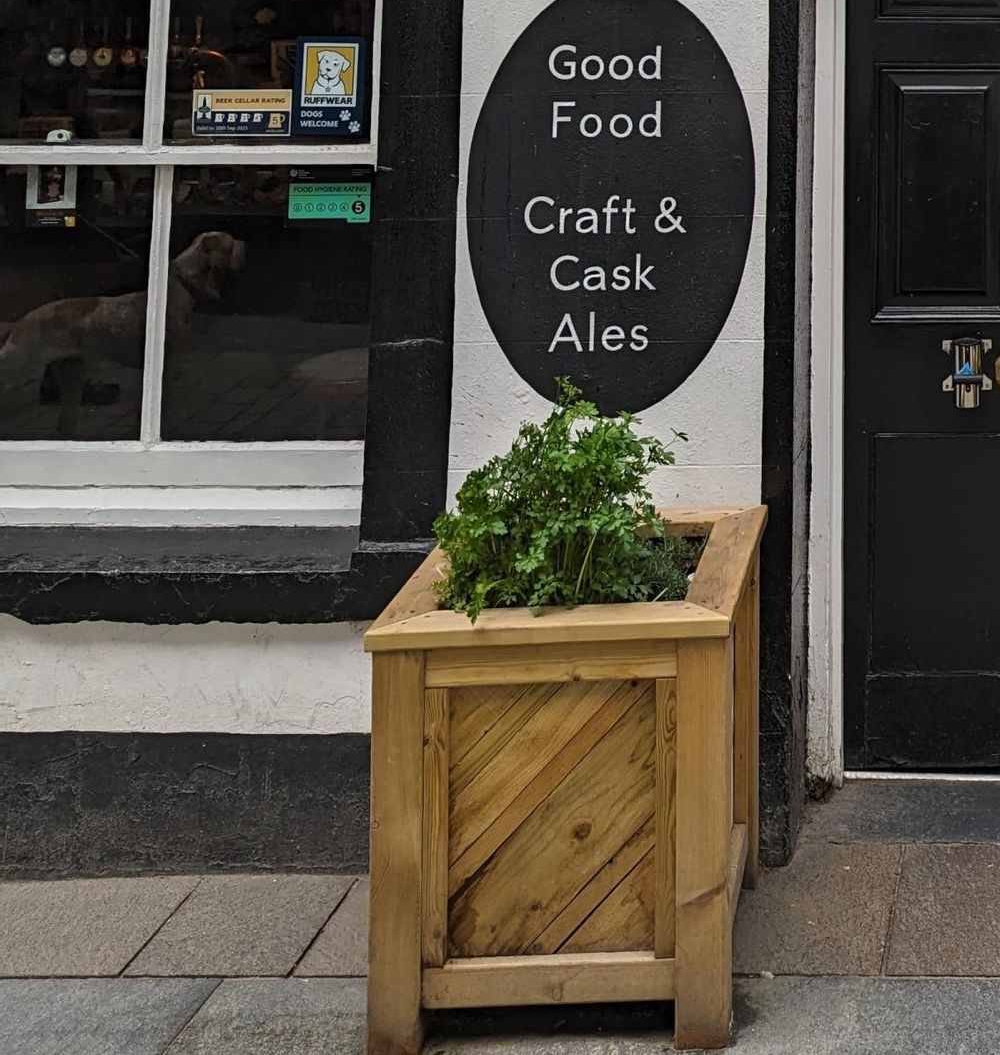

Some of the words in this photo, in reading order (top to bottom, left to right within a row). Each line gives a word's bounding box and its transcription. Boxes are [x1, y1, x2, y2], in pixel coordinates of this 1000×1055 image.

[549, 44, 662, 80] Good
[304, 97, 353, 105] RUFFWEAR
[271, 116, 279, 125] 5
[300, 110, 323, 118] DOGS
[300, 120, 338, 128] WELCOME
[551, 100, 662, 138] Food
[354, 202, 363, 213] 5
[523, 194, 637, 235] Craft
[654, 196, 687, 234] &
[549, 253, 657, 292] Cask
[547, 311, 649, 353] Ales
